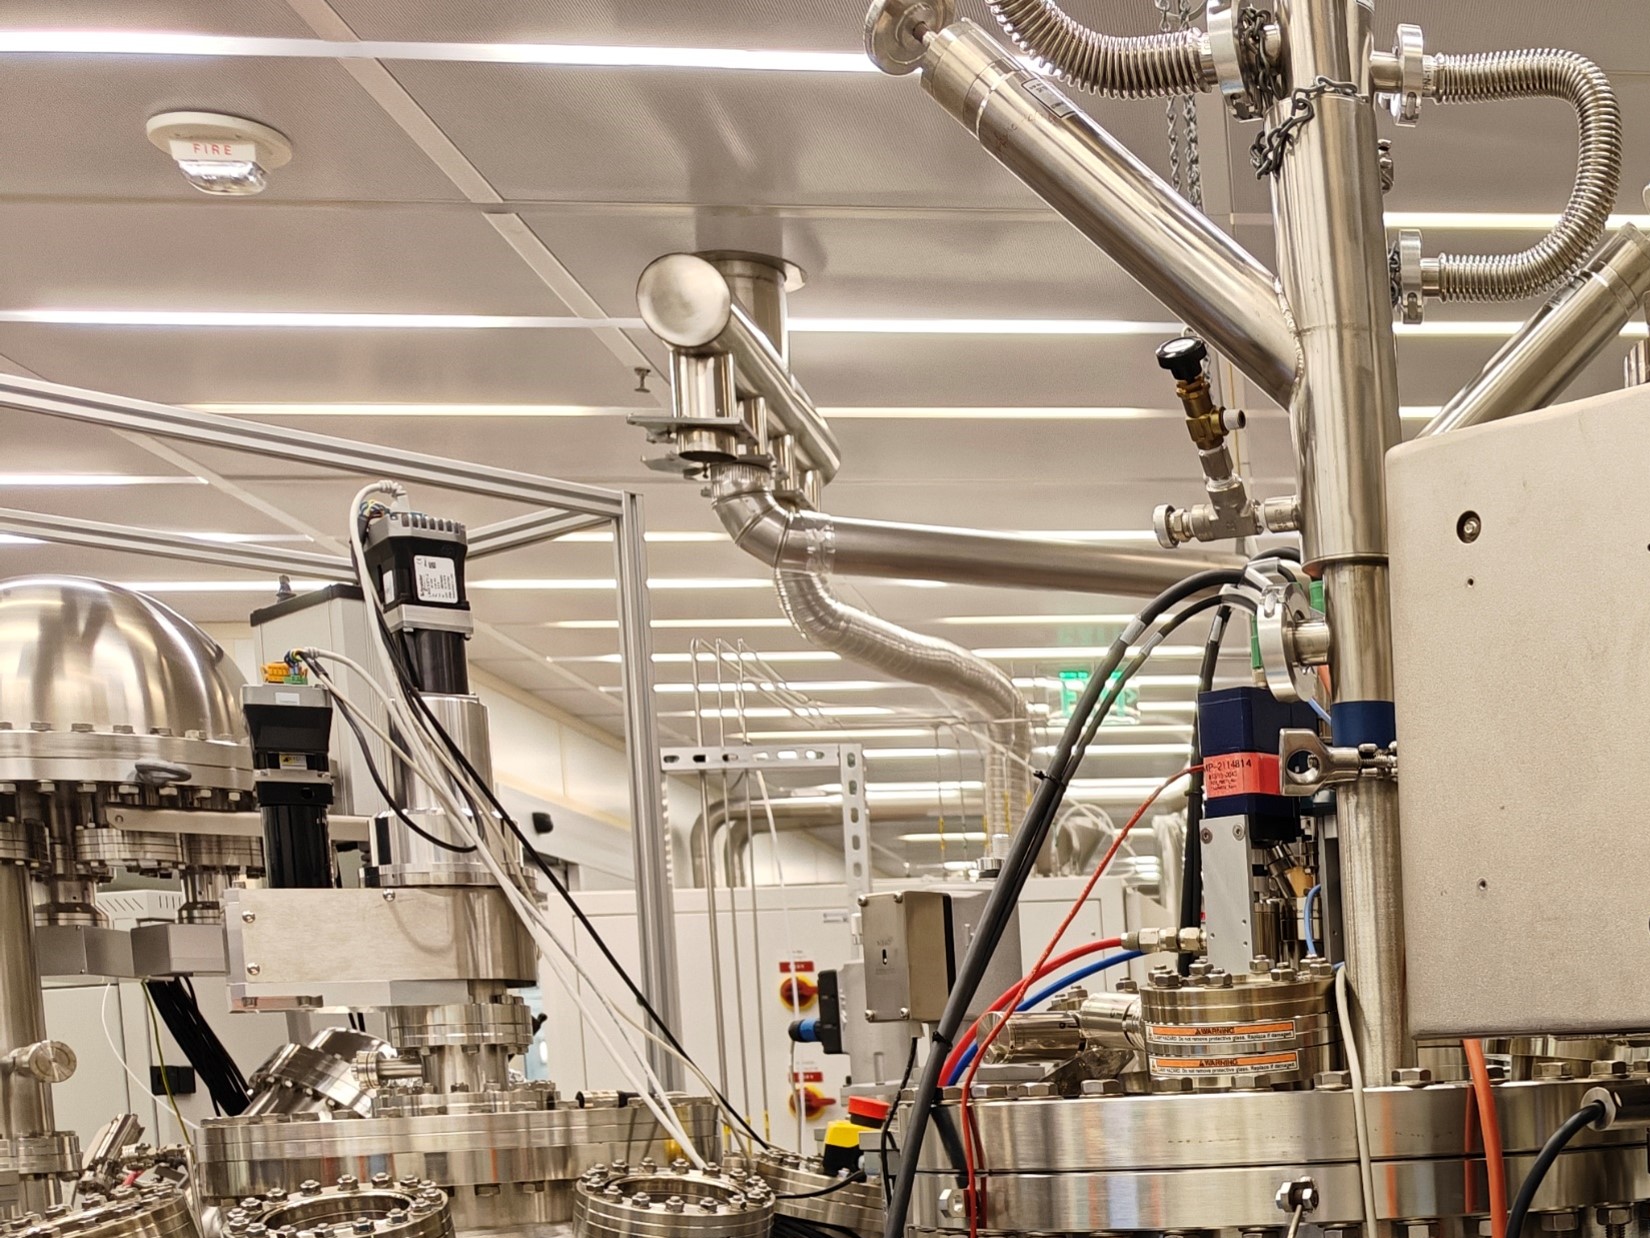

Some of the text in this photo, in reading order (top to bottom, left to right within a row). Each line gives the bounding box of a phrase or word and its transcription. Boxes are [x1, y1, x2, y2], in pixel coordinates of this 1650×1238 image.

[193, 143, 232, 156] FIRE
[1201, 1026, 1235, 1035] WARNING
[1205, 1058, 1238, 1067] WARNING
